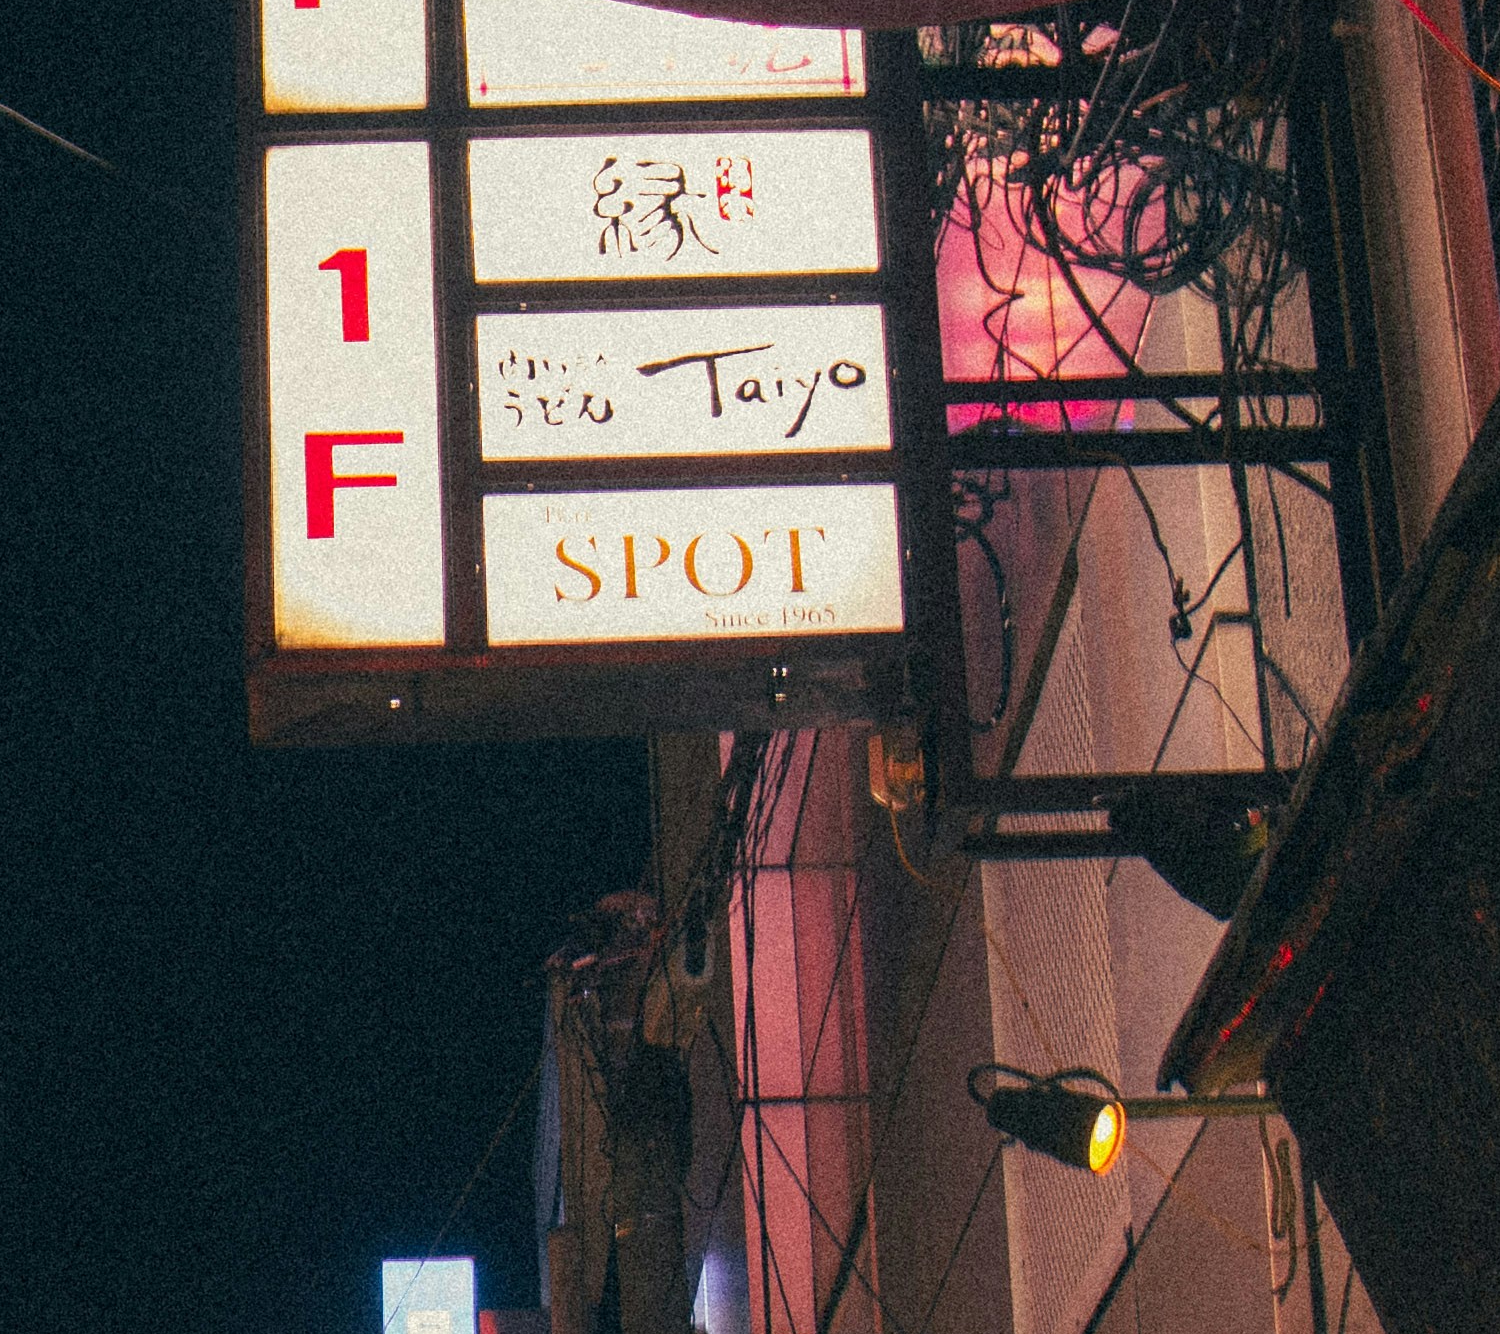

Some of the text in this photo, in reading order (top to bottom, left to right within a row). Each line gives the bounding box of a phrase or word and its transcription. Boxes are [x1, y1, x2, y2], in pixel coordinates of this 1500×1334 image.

[593, 156, 720, 263] 縁
[503, 384, 615, 428] うどん
[636, 342, 867, 438] Taiyo
[554, 526, 826, 603] SPOT
[704, 602, 838, 630] Since 1965
